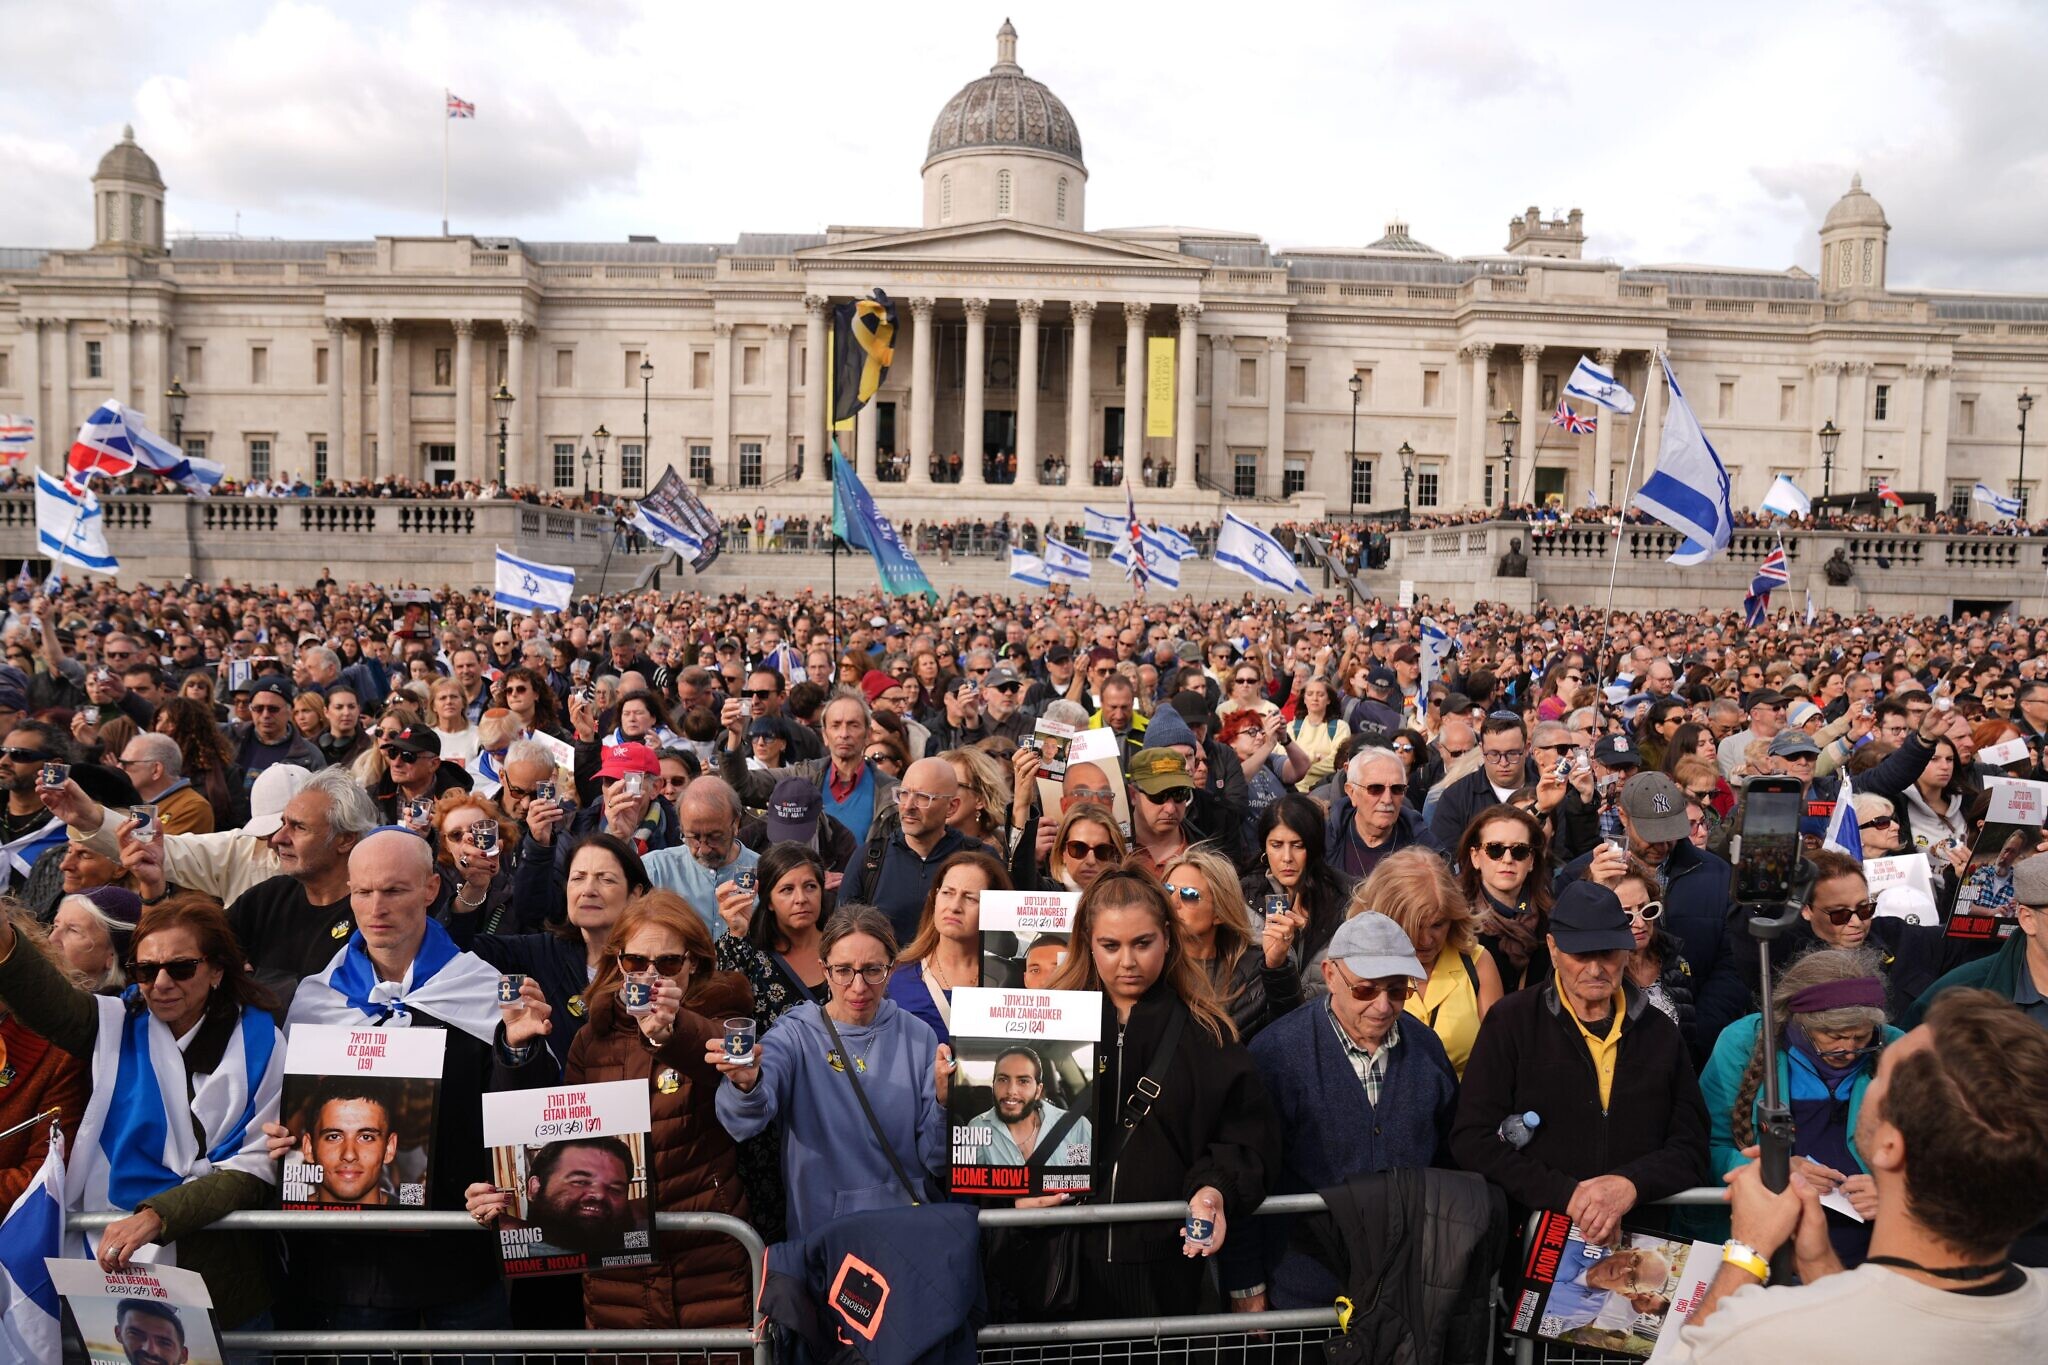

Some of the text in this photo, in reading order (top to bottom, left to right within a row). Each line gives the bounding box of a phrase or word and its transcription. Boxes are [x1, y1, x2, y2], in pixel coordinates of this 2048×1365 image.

[1359, 719, 1387, 735] CST
[1959, 885, 1981, 901] BRING
[1017, 906, 1068, 917] MATAN ANGREST
[1954, 900, 1971, 915] HIM
[1950, 916, 1973, 932] HOME
[1973, 917, 1995, 933] NOW!
[990, 1006, 1062, 1020] MATAN ZANGAUKER
[1005, 1020, 1027, 1033] (25)
[350, 1031, 387, 1045] עוז דניאל
[347, 1045, 386, 1057] OZ DANIEL
[357, 1057, 373, 1070] (19)
[547, 1091, 586, 1108] איתן הורן
[543, 1105, 592, 1121] EITAN HORN
[952, 1125, 993, 1146] BRING
[952, 1145, 977, 1165] HIM
[283, 1164, 324, 1183] BRING
[952, 1166, 1029, 1187] HOME NOW!
[282, 1182, 308, 1201] HIM
[1042, 1180, 1091, 1189] FAMILIES FORUM
[500, 1227, 543, 1245] BRING
[501, 1243, 530, 1260] HIM
[1533, 1213, 1571, 1283] HOME NOW!
[503, 1253, 587, 1273] HOME NOW!
[602, 1257, 652, 1267] FAMILIES FORUM
[105, 1275, 160, 1287] GALI BERMAN
[840, 1293, 871, 1318] CHEROKEE
[1674, 1298, 1690, 1313] (85)
